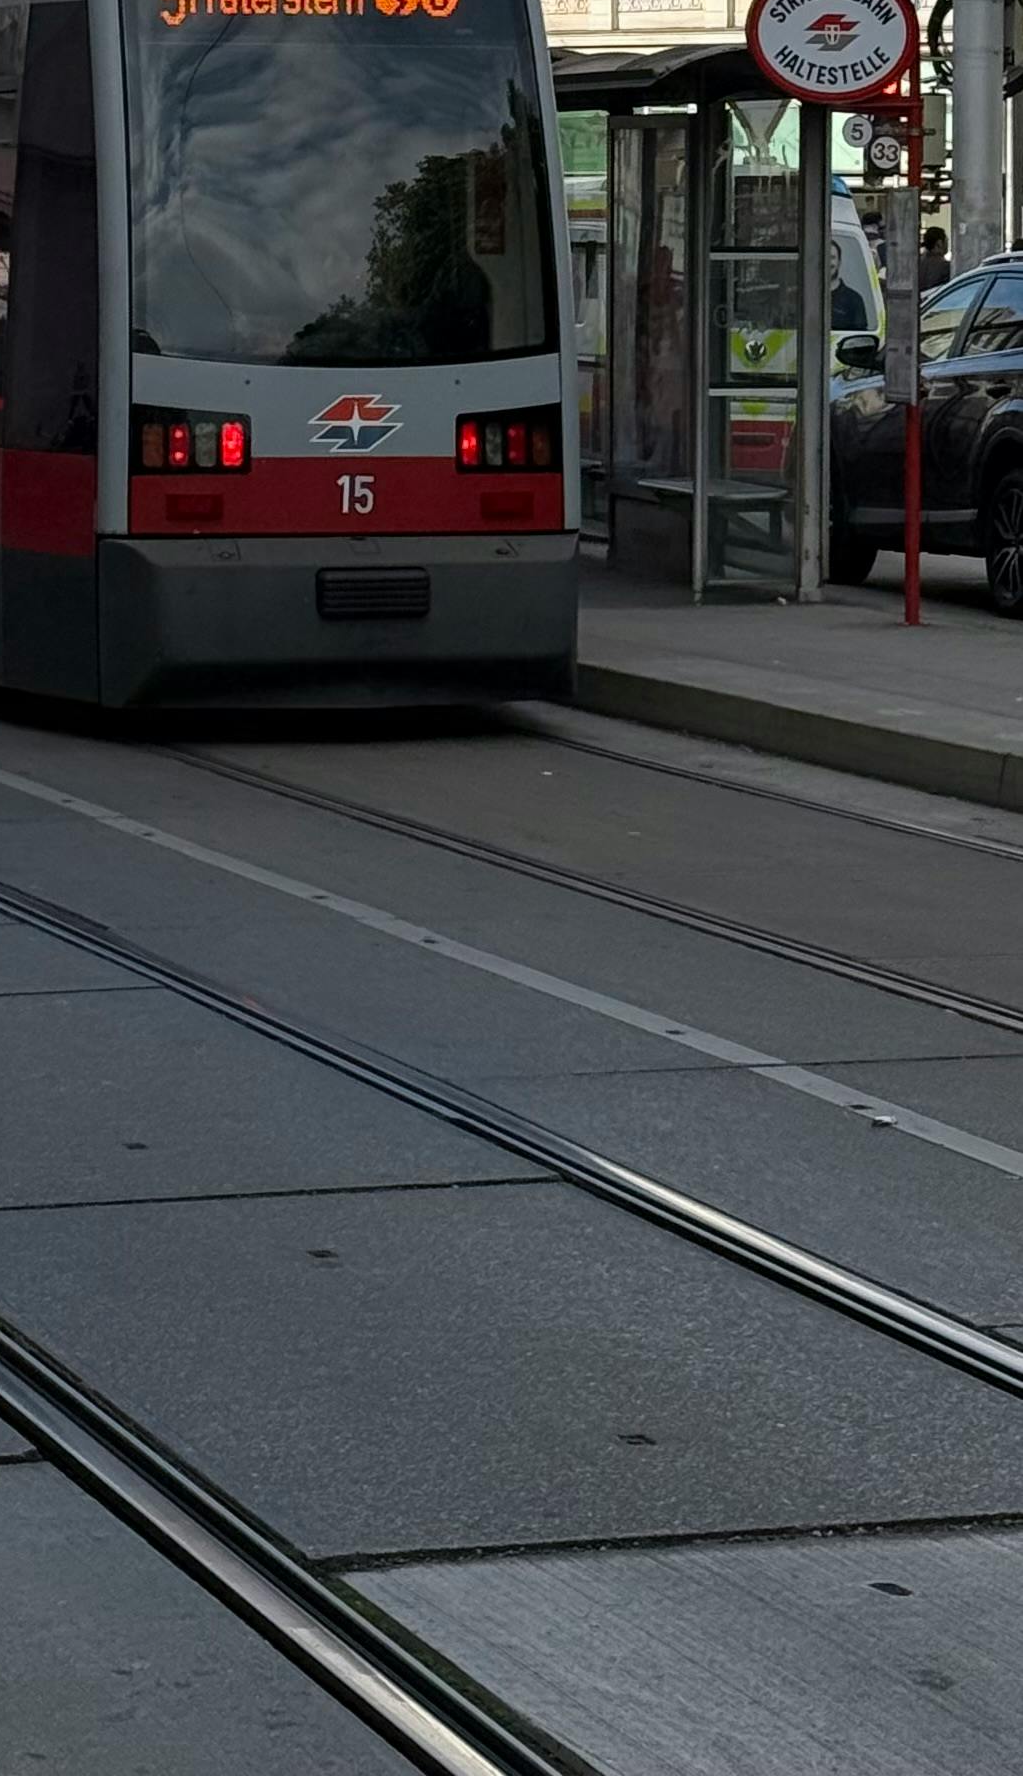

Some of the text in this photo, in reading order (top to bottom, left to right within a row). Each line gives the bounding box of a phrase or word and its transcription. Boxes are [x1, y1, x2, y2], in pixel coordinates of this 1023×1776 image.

[774, 45, 890, 85] HALTESTELLE
[850, 123, 864, 140] 5
[873, 143, 899, 162] 33
[336, 475, 375, 514] 15
